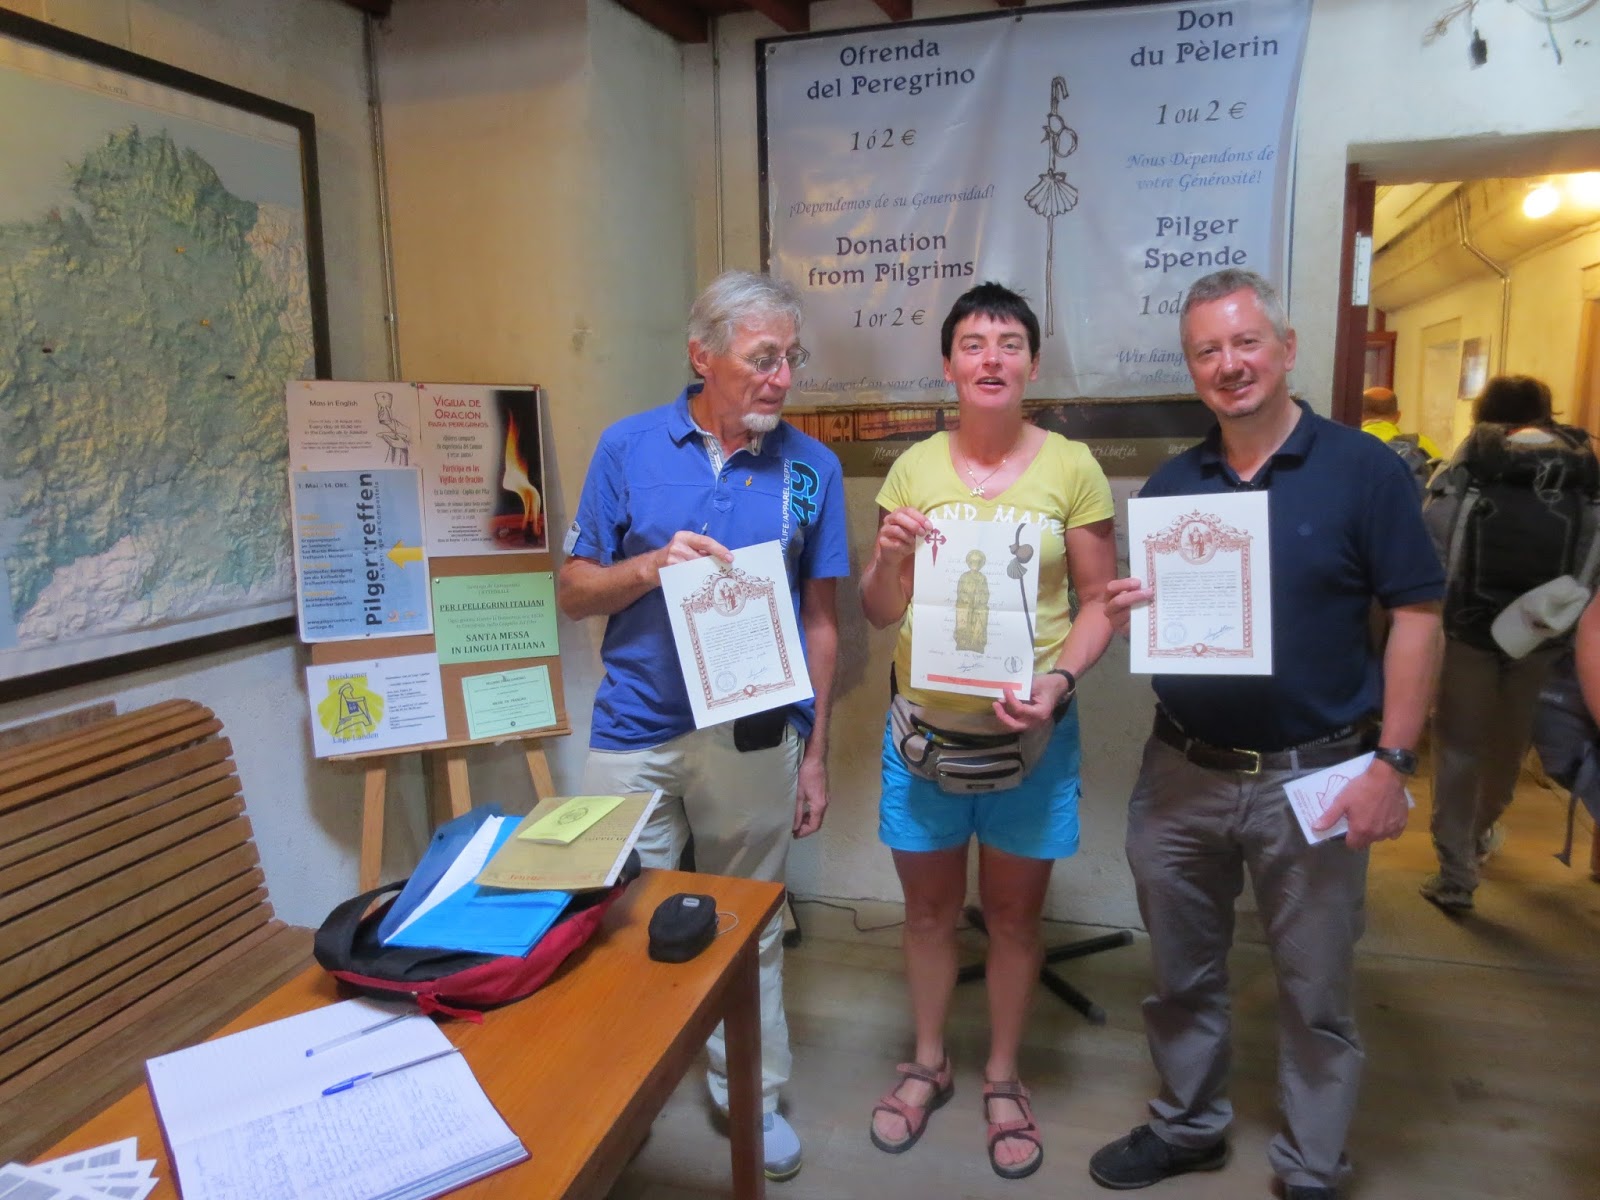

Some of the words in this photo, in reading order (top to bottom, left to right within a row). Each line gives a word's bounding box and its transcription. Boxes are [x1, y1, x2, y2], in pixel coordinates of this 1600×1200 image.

[1177, 10, 1233, 31] Don
[840, 39, 940, 66] Ofrenda
[1130, 47, 1164, 67] du
[1176, 36, 1278, 64] Pèlerin
[807, 79, 841, 100] del
[851, 67, 975, 95] Peregrino
[1156, 104, 1168, 125] 1
[1175, 106, 1199, 124] ou
[1204, 100, 1220, 122] 2
[1228, 101, 1247, 120] €
[851, 131, 860, 151] 1
[881, 128, 894, 148] 2
[900, 129, 916, 146] €
[1126, 153, 1165, 169] Nous
[1257, 145, 1275, 162] de
[874, 193, 889, 209] de
[894, 194, 907, 208] su
[912, 184, 995, 210] Generosidad!
[1156, 216, 1239, 241] Pilger
[836, 233, 946, 256] Donation
[1145, 246, 1247, 273] Spende
[808, 267, 865, 286] from
[874, 260, 975, 287] Pilgrims
[1140, 295, 1150, 315] 1
[1158, 291, 1182, 315] od
[853, 309, 862, 328] 1
[868, 310, 887, 328] or
[891, 307, 904, 327] 2
[911, 309, 926, 326] €
[1149, 347, 1187, 368] häng
[918, 376, 957, 389] Gener
[790, 460, 819, 527] 49
[929, 503, 977, 521] AND
[440, 604, 456, 612] PER
[509, 600, 544, 608] ITALIANI
[464, 644, 499, 654] LINGUA
[501, 641, 545, 651] ITALIANA
[466, 632, 497, 642] SANTA
[500, 631, 530, 640] MESSA
